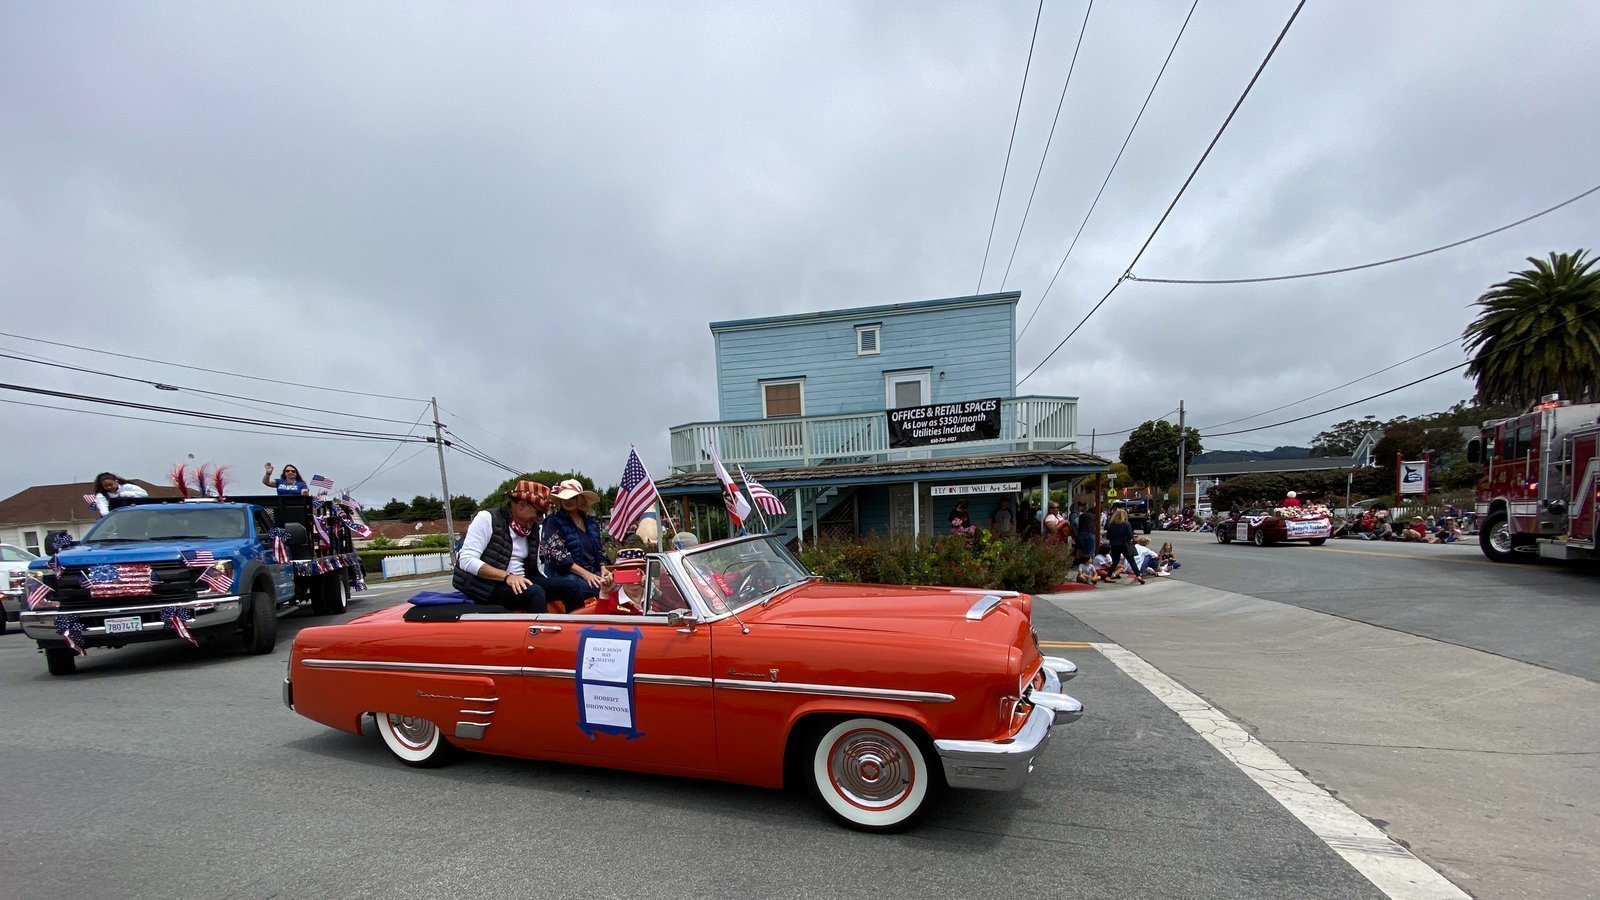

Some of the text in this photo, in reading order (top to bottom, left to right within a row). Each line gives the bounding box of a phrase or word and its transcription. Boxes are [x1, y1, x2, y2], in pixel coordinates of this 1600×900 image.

[891, 400, 997, 422] OFFICES & RETAIL SPACES
[902, 413, 986, 430] As Low as $350/month
[912, 423, 976, 438] Utilities Included
[971, 485, 986, 493] WALL
[593, 695, 620, 703] ROBERT
[586, 703, 630, 713] BROWNSTONE
